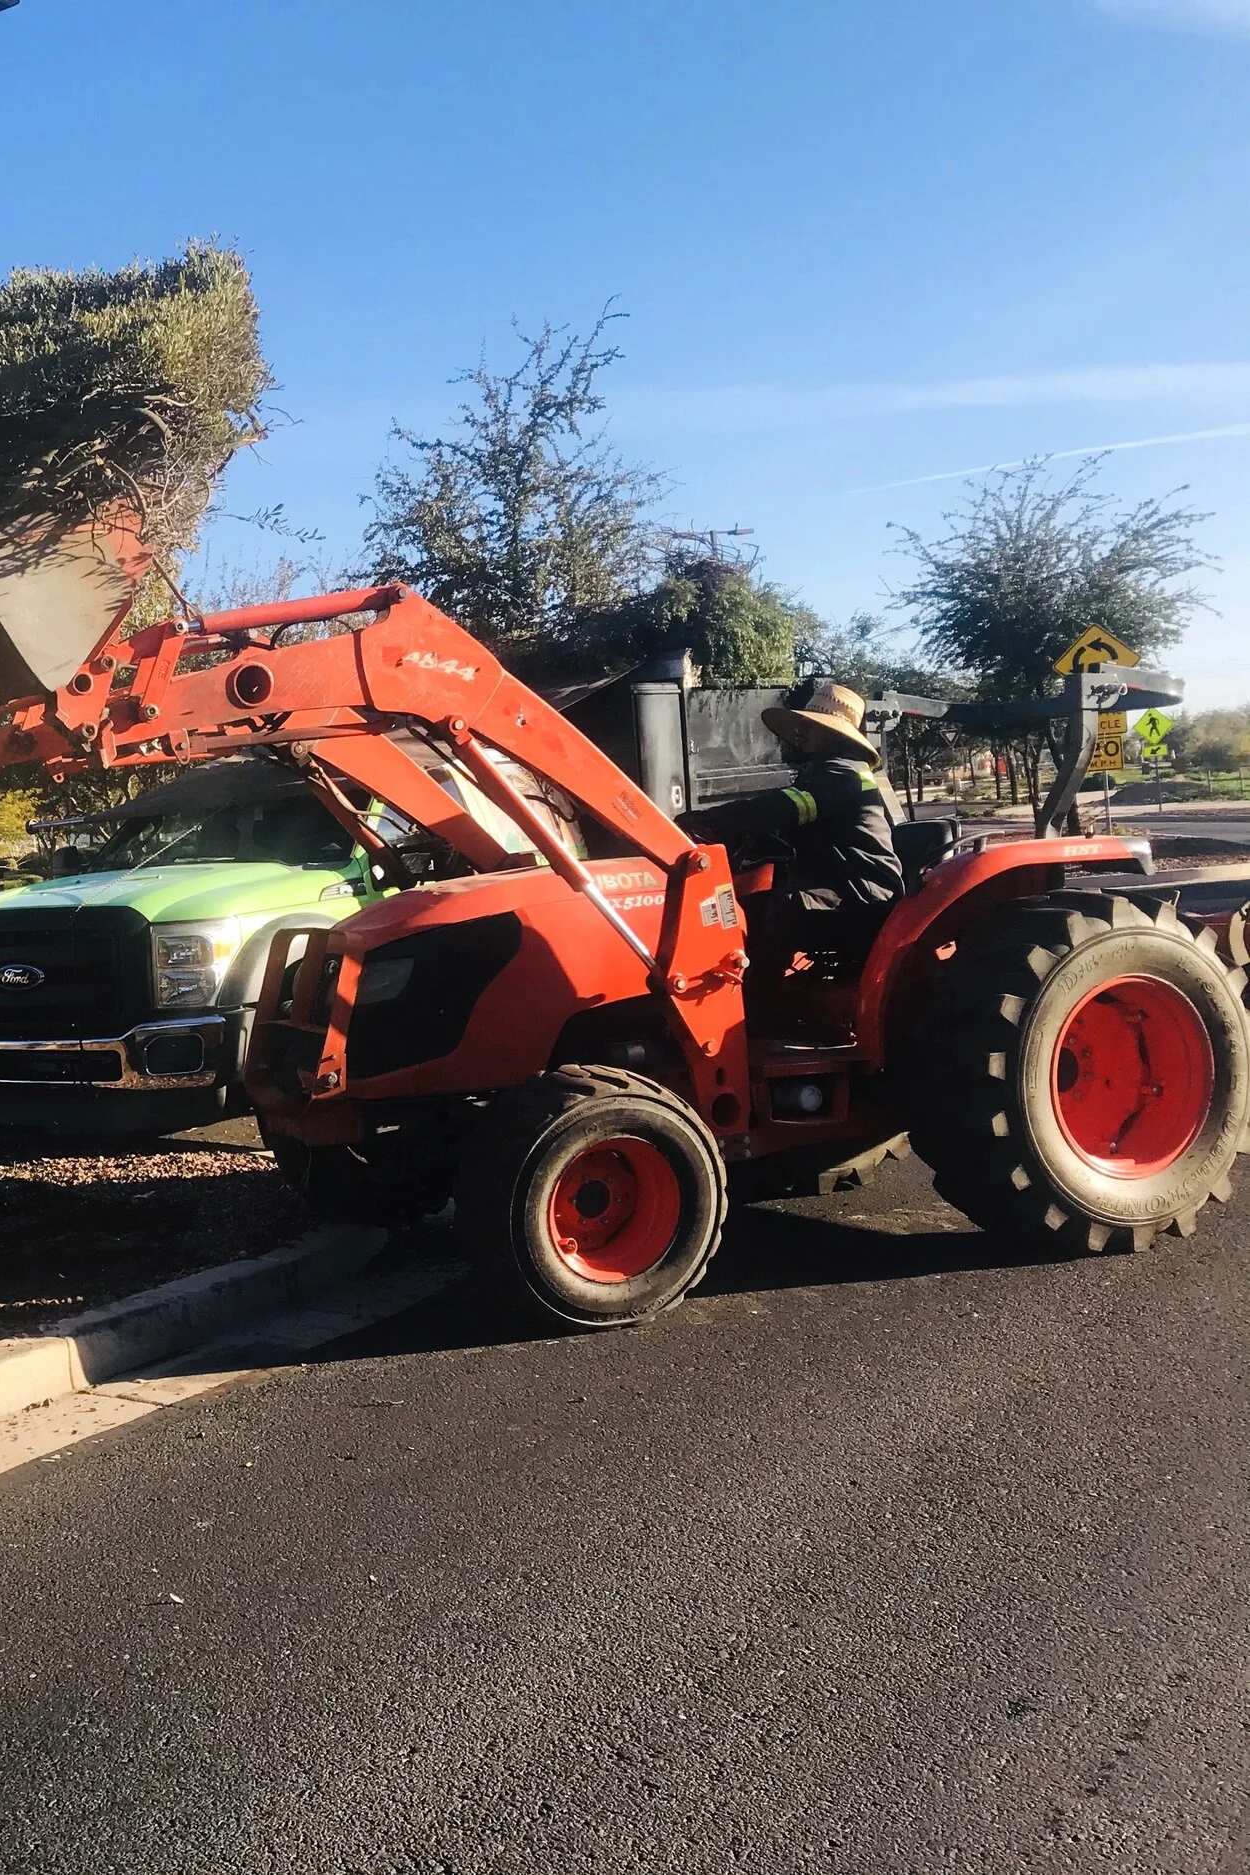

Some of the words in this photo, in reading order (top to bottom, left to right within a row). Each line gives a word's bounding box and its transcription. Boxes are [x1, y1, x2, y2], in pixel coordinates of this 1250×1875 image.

[1100, 720, 1121, 730] CLE
[595, 871, 662, 890] BOTA
[609, 894, 665, 911] X5100
[1, 968, 29, 984] Ford
